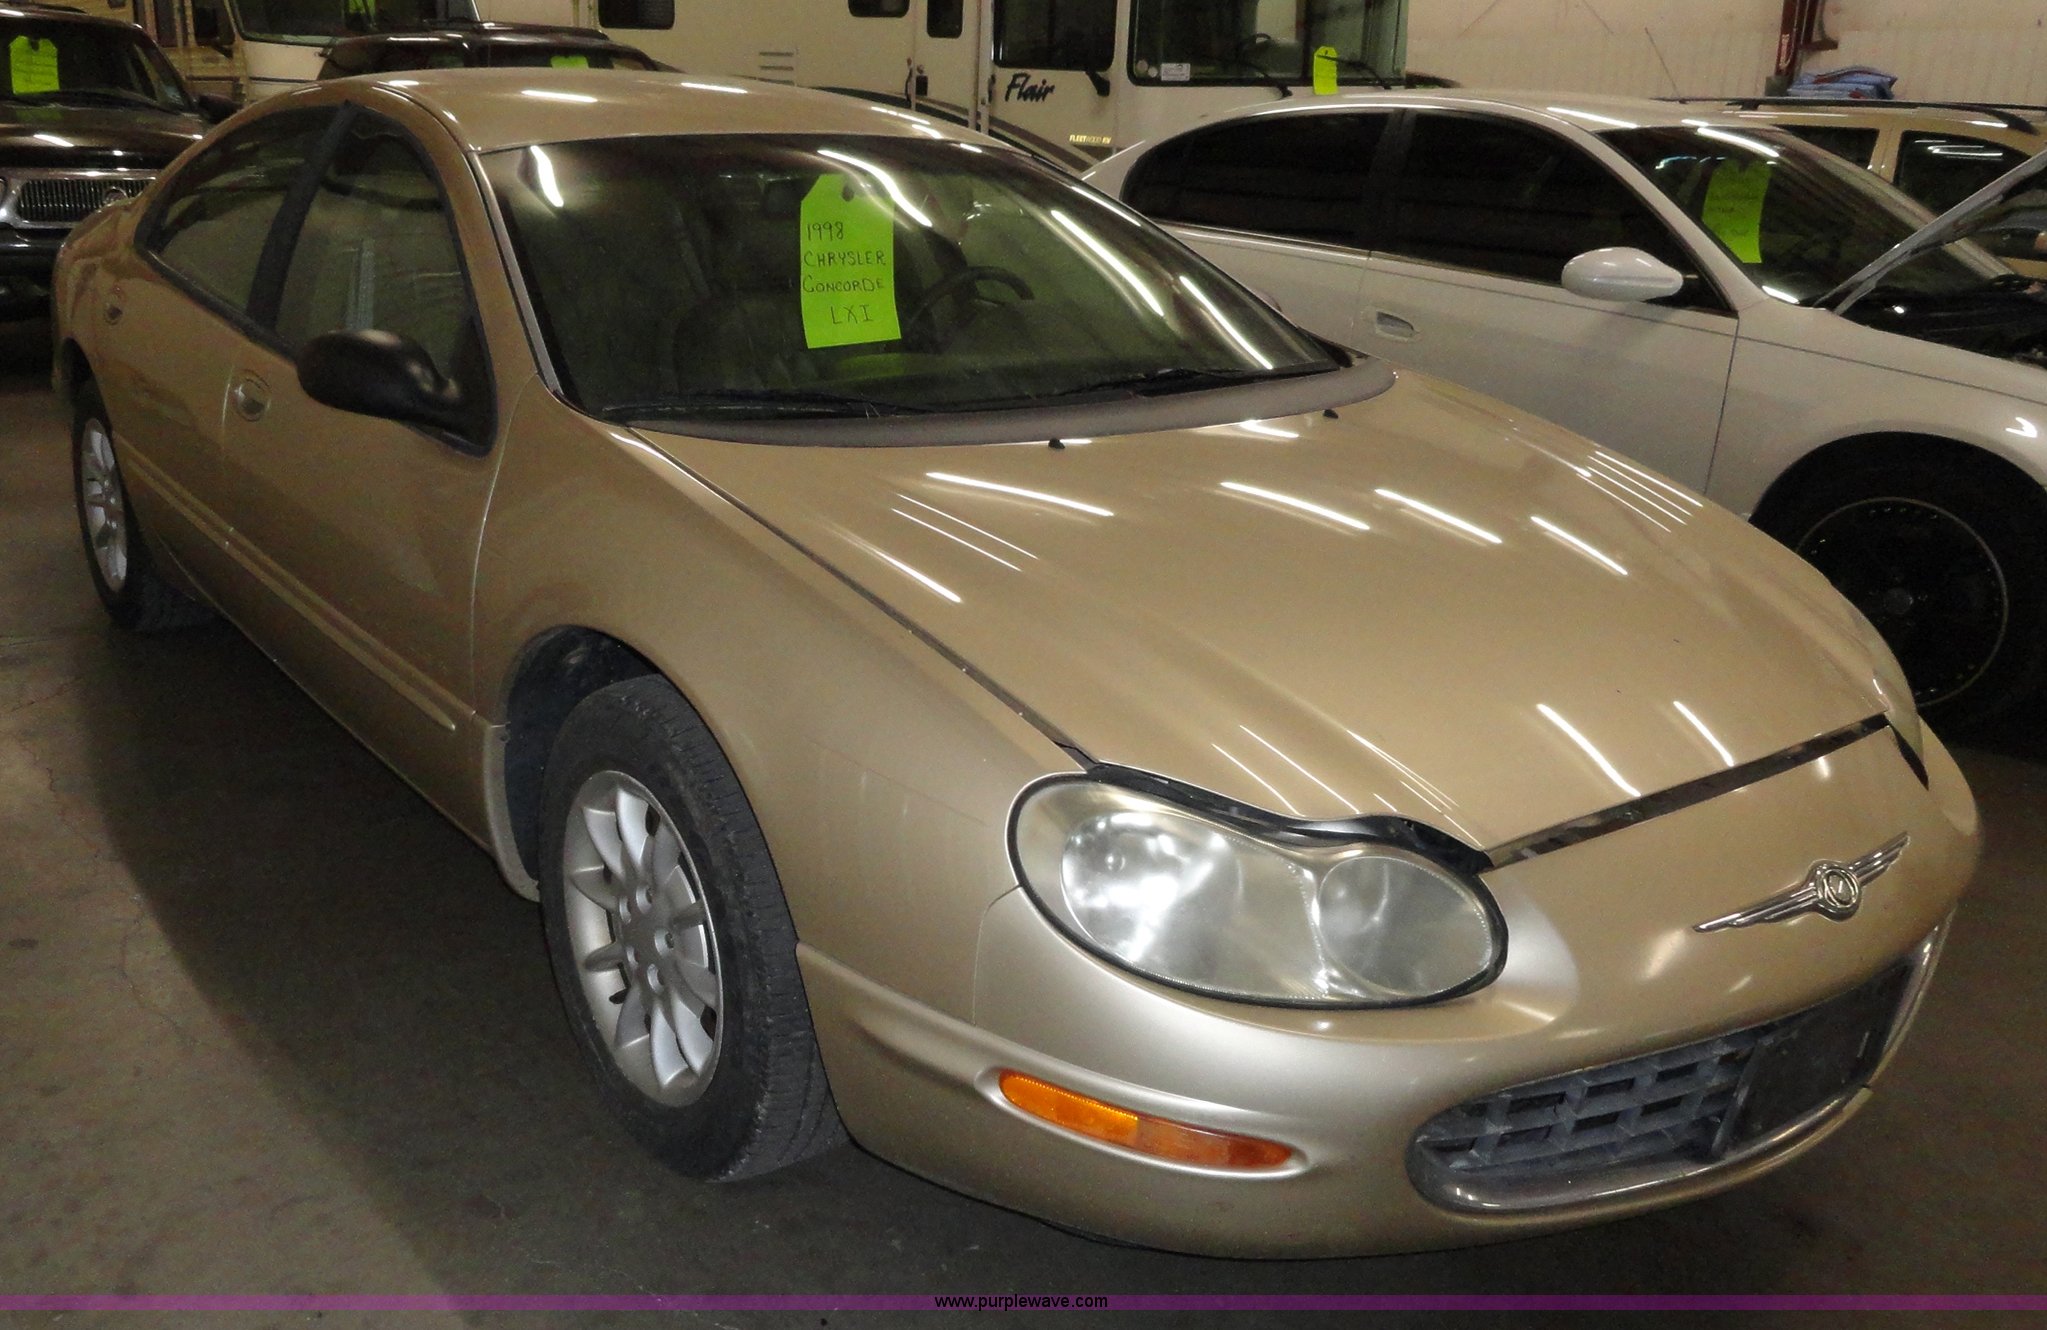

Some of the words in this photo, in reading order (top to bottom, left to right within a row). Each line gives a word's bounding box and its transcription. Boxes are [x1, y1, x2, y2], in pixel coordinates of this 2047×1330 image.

[1005, 73, 1056, 102] Flair
[807, 221, 844, 241] 1998
[804, 250, 886, 267] CHRYSLER
[831, 305, 874, 324] LXI
